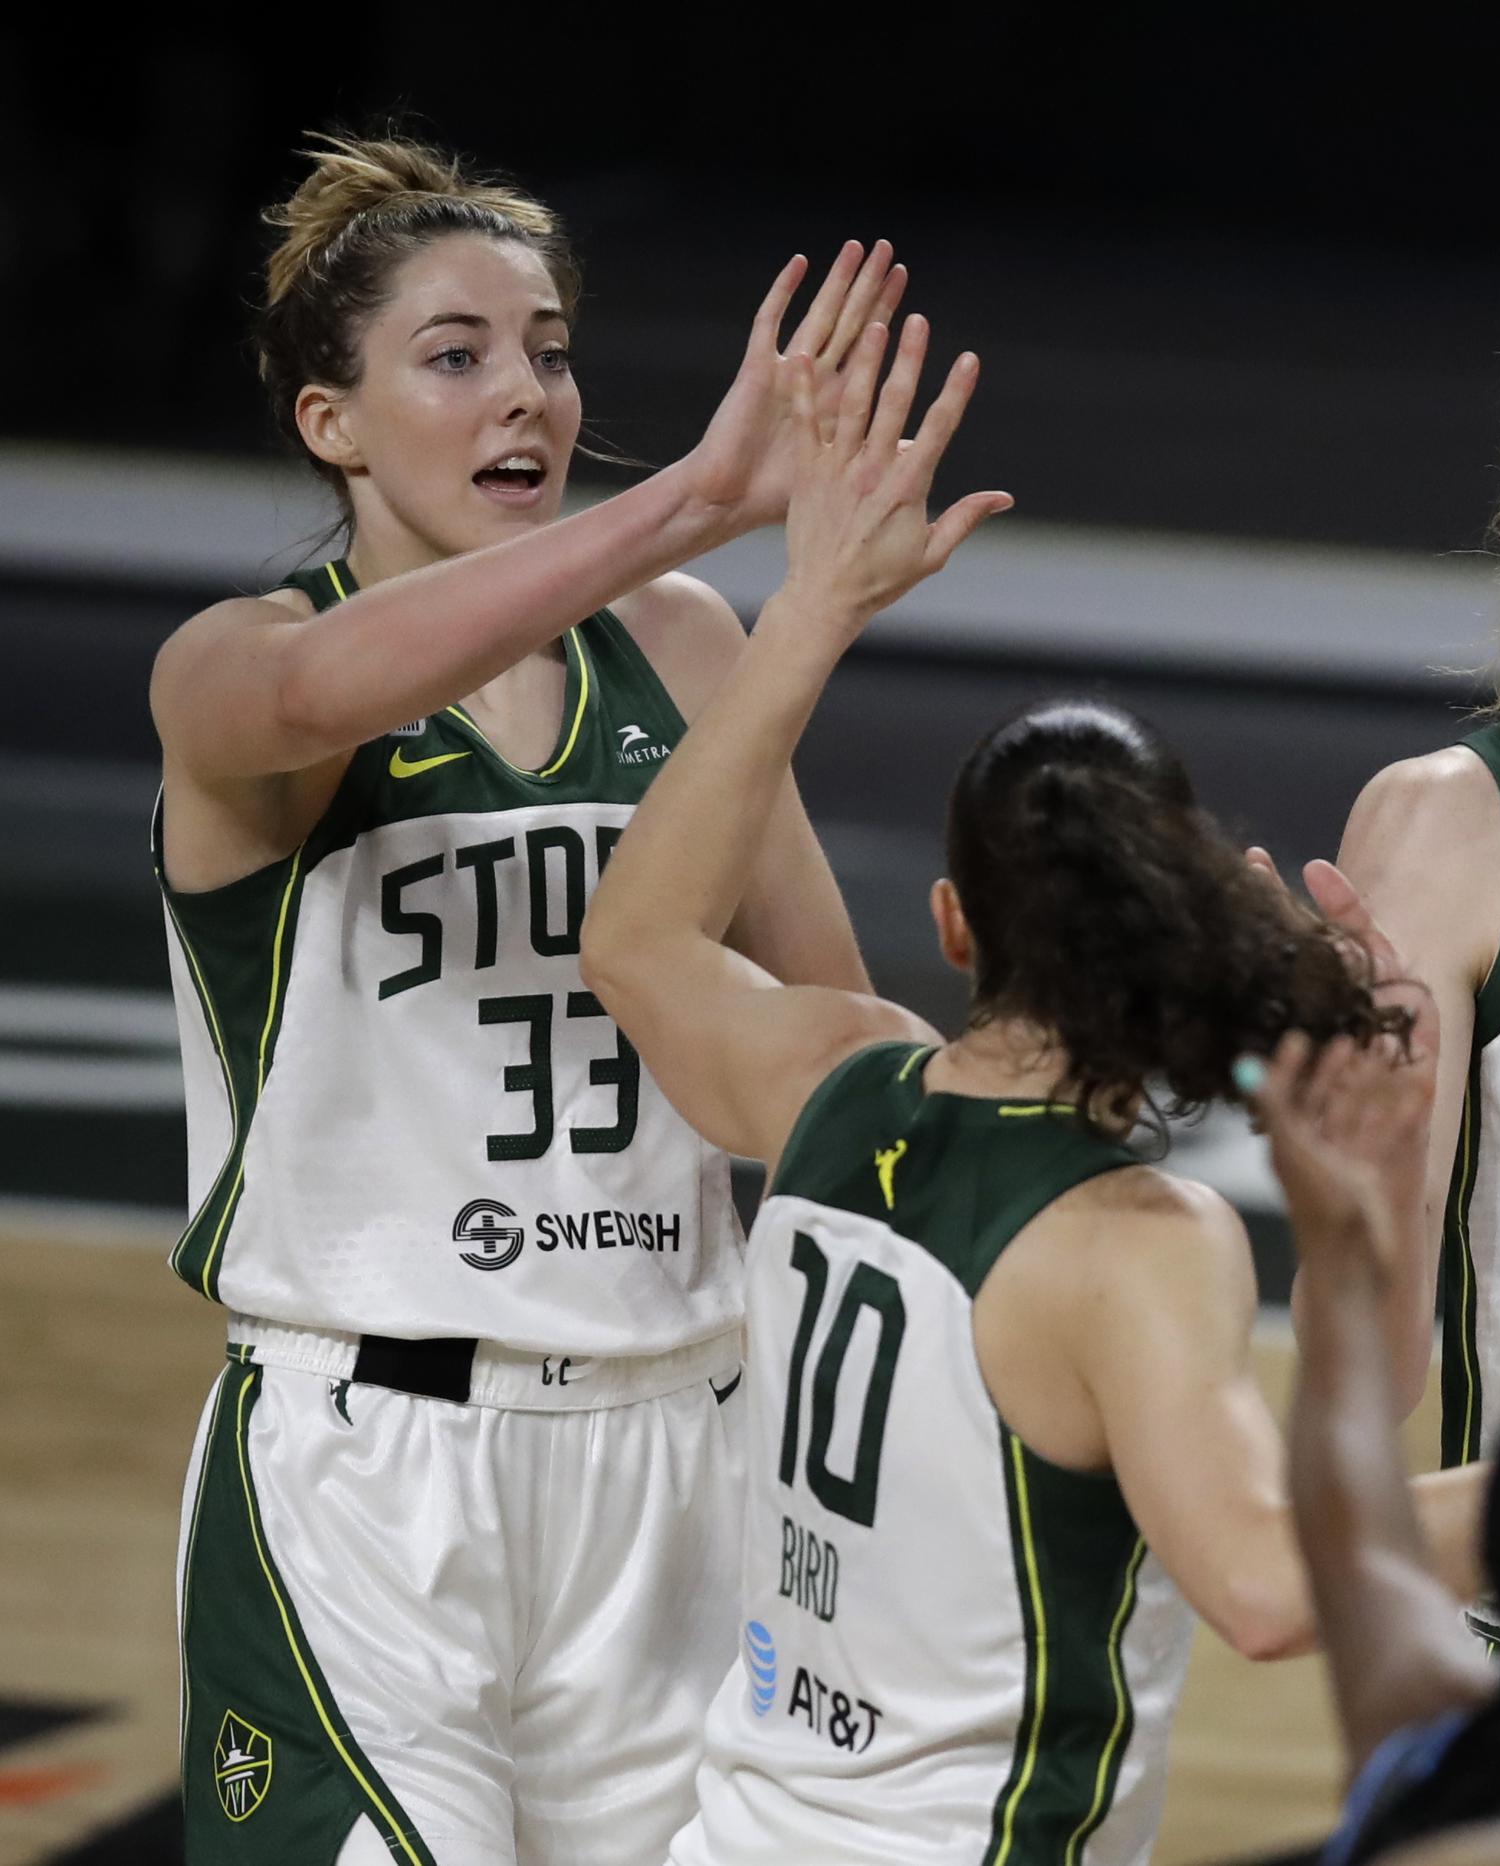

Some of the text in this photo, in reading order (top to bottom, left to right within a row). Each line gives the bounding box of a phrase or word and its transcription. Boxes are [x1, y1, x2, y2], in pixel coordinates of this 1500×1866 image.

[378, 825, 626, 1000] STO
[479, 992, 640, 1162] 33
[536, 1210, 680, 1252] SWEDISH
[778, 1230, 906, 1528] 10
[779, 1516, 840, 1624] BIRD
[788, 1666, 884, 1754] AT&T
